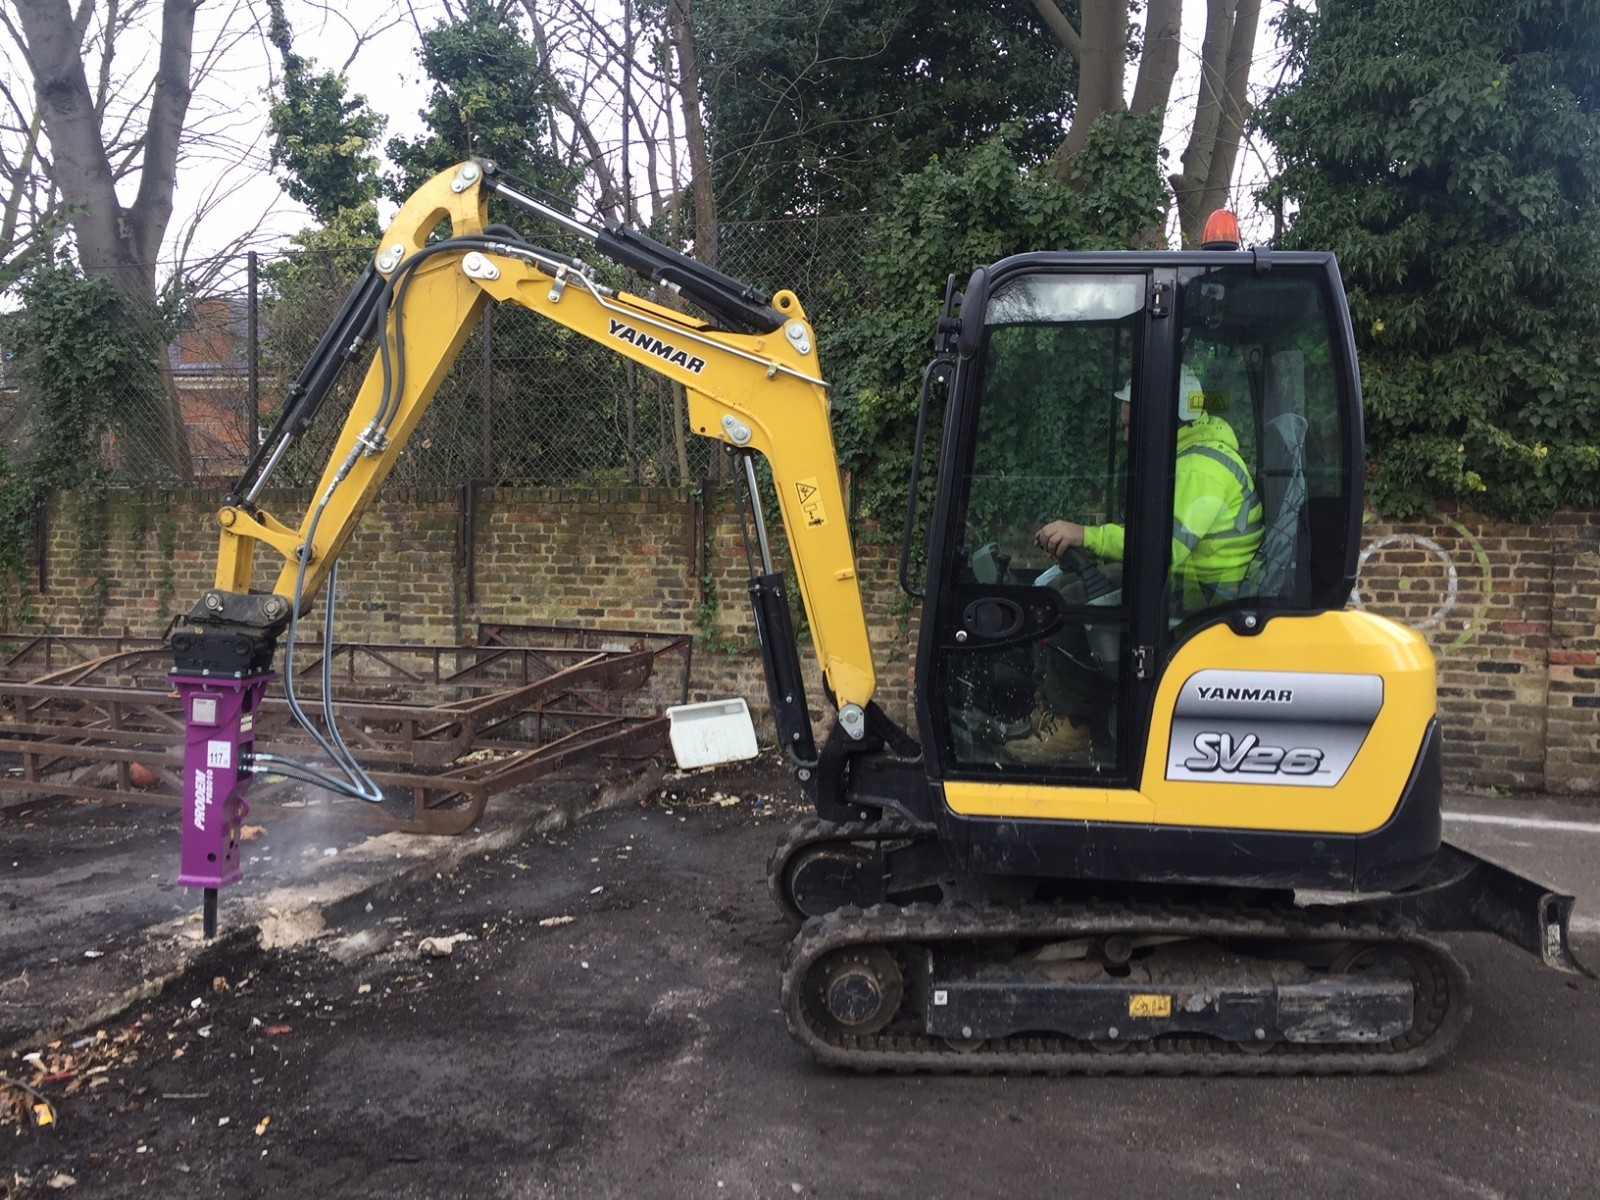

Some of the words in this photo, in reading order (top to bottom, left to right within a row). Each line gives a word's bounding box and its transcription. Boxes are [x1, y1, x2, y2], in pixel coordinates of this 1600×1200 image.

[609, 319, 706, 374] YANMAR
[1197, 686, 1293, 702] YANMAR
[210, 752, 223, 764] 117
[1184, 731, 1325, 775] SV26
[194, 768, 206, 831] PRODEM
